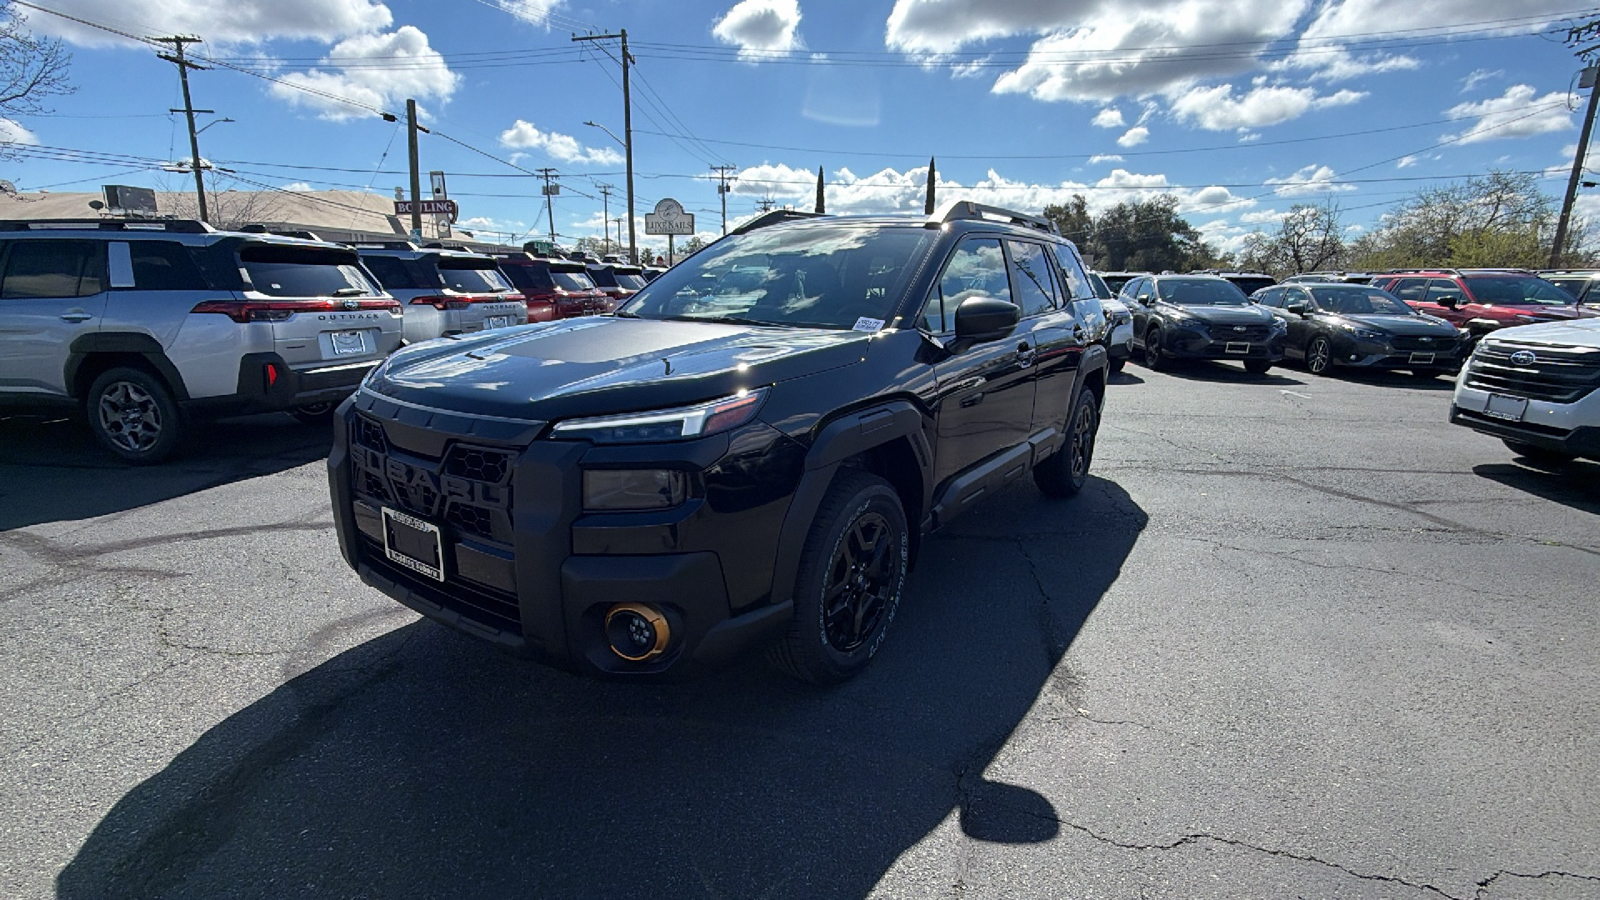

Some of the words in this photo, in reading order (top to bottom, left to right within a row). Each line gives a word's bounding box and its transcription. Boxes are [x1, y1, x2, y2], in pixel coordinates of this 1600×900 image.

[398, 201, 453, 213] BOLING
[667, 220, 692, 229] NAILS
[317, 313, 379, 321] OUTBACK
[351, 444, 509, 510] SUBARU
